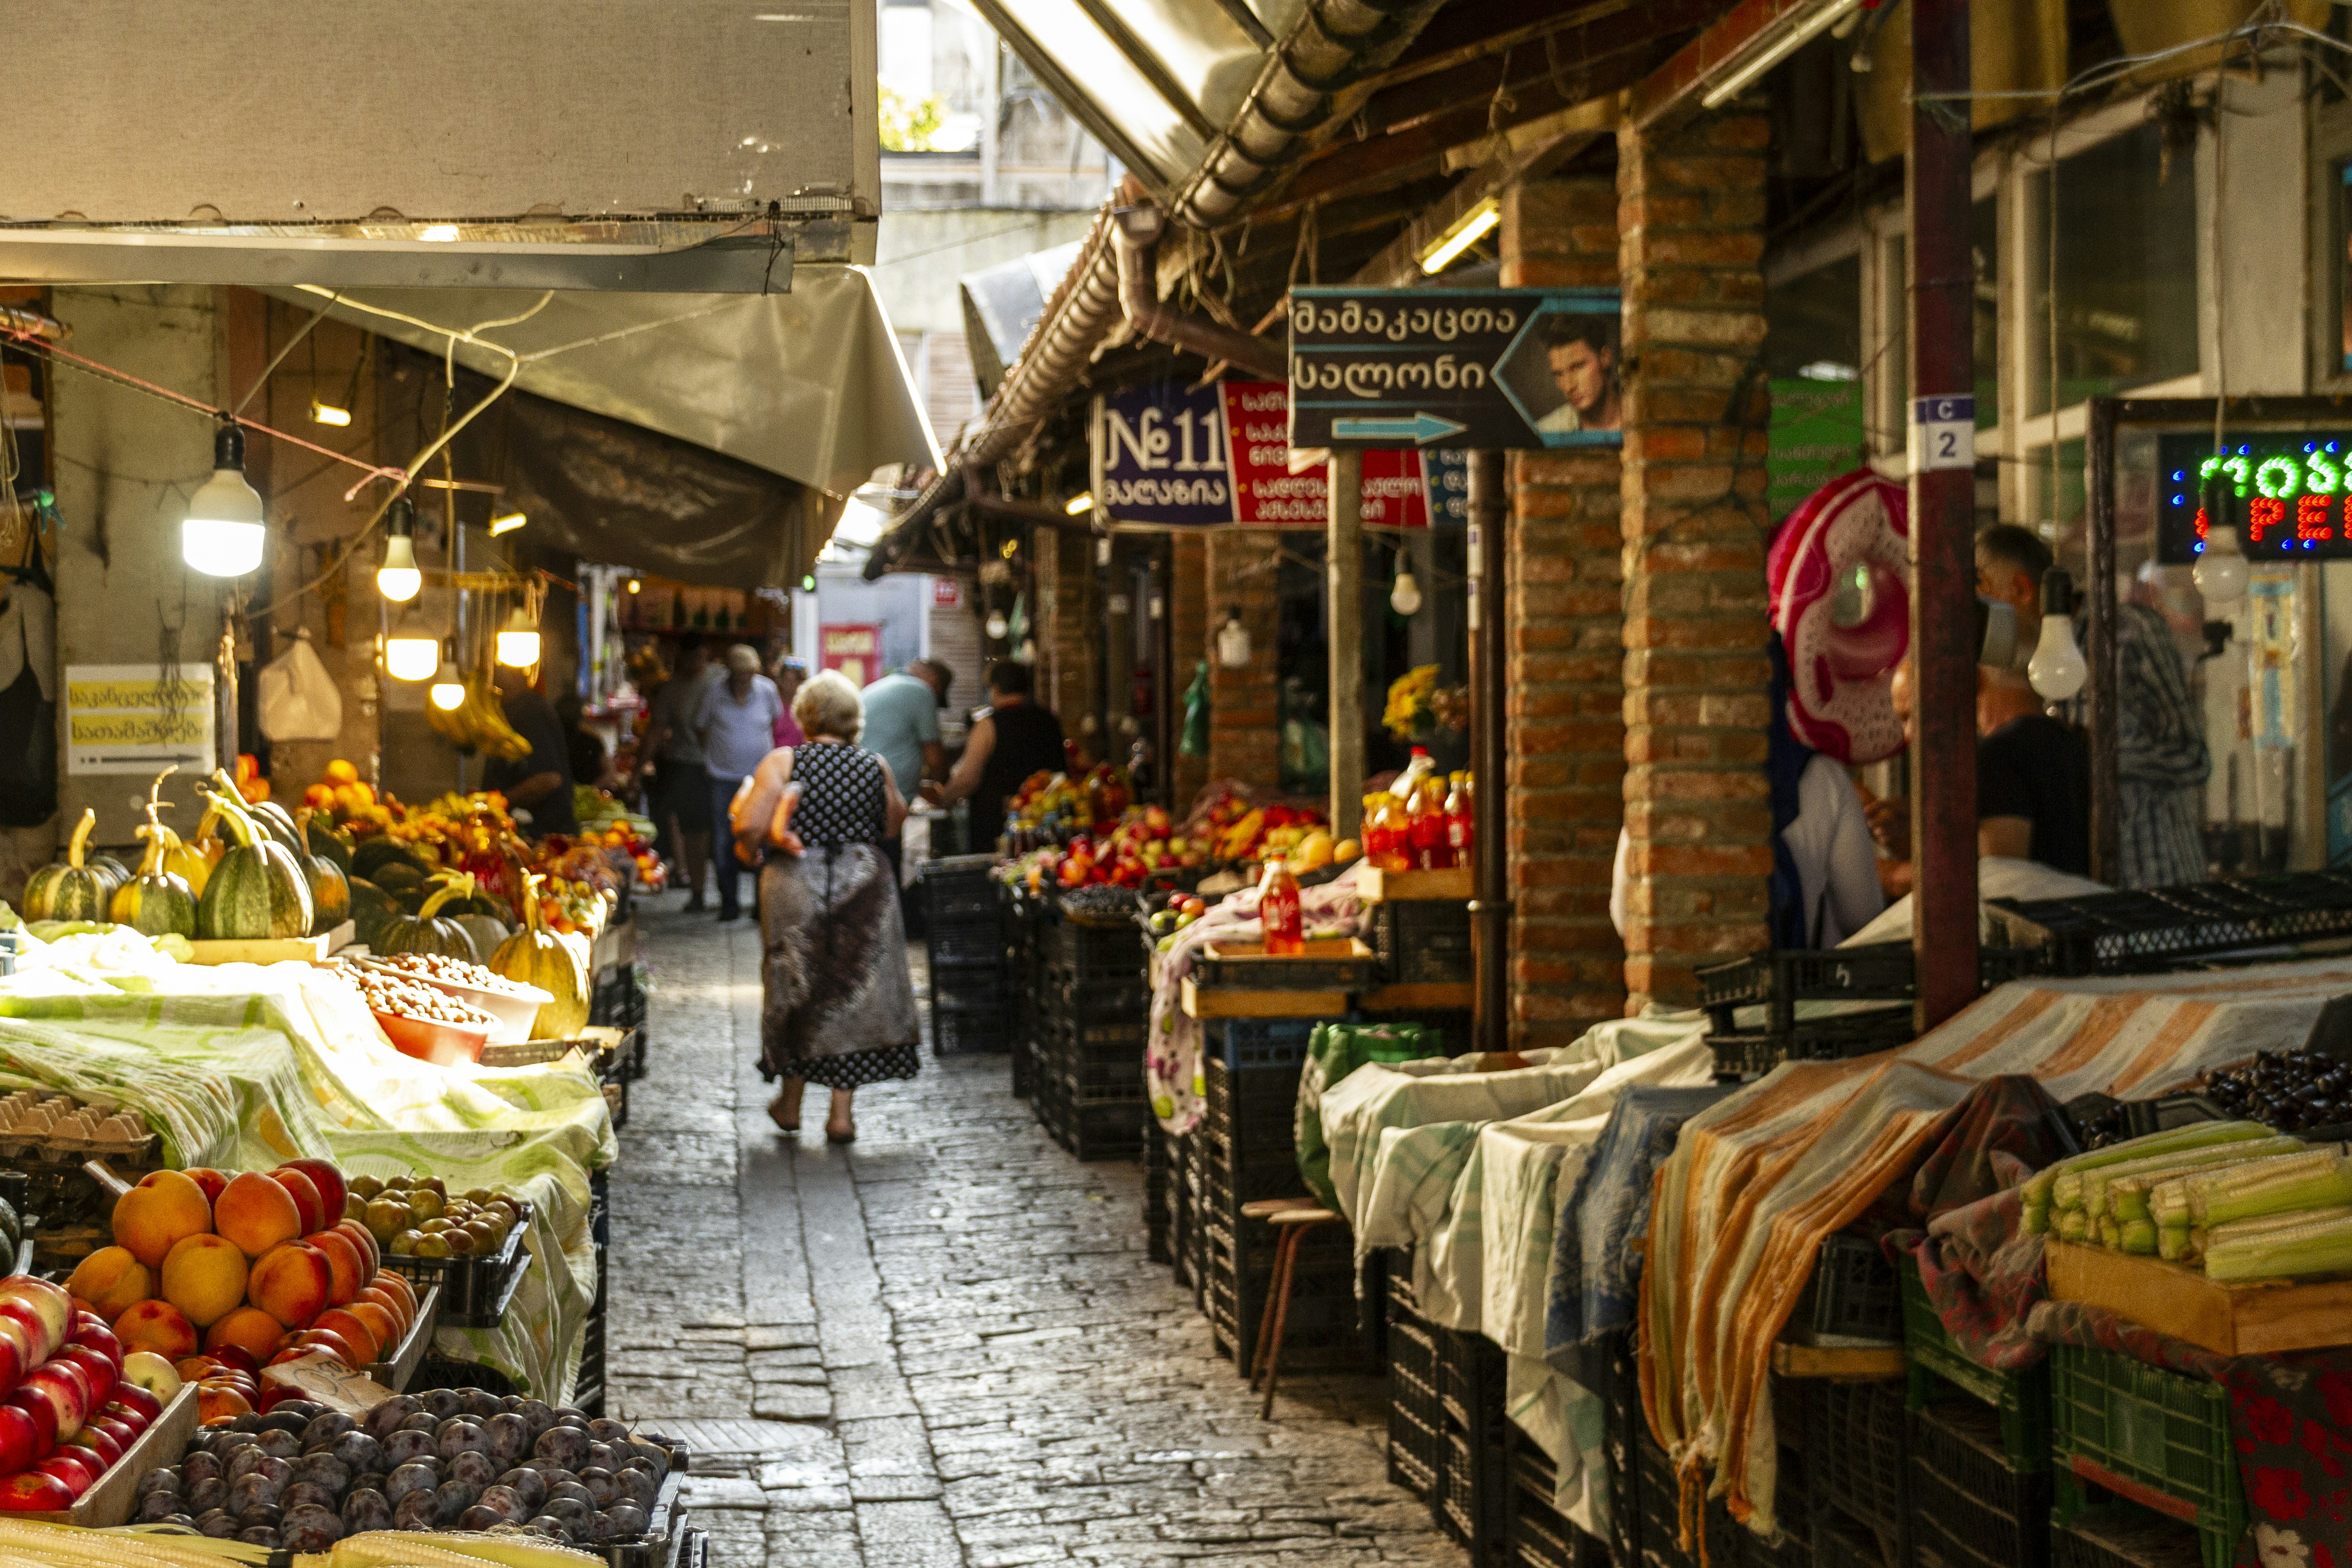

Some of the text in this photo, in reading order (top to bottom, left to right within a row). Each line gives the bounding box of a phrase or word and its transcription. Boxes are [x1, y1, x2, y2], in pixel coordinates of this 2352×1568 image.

[1294, 300, 1517, 341] მამაკაცთა
[1294, 354, 1485, 397] სალონი
[1938, 431, 1956, 458] 2
[1102, 478, 1227, 506] მაღაზია
[2194, 495, 2352, 542] PE
